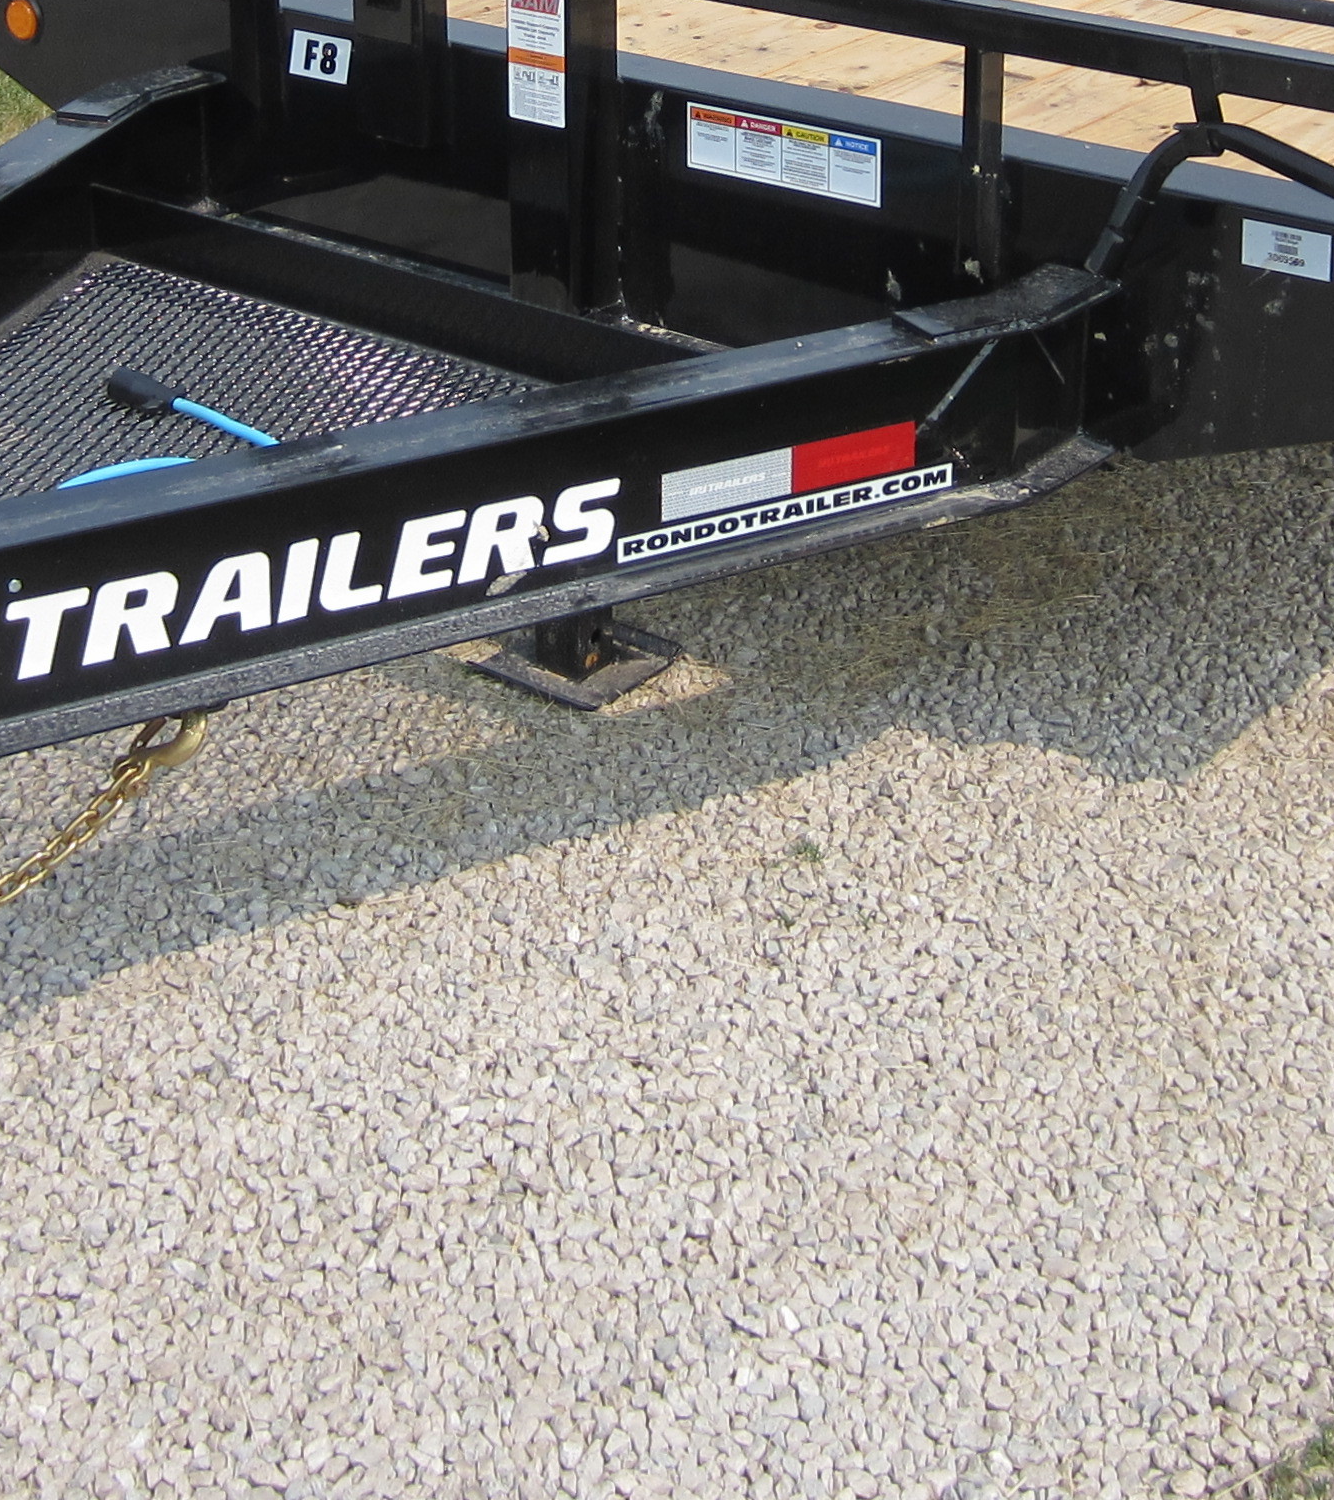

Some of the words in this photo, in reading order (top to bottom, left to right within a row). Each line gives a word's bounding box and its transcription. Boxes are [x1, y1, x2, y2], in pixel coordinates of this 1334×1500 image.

[304, 38, 338, 75] F8
[749, 121, 777, 133] DANGER
[795, 131, 825, 143] CAUTION
[845, 140, 870, 151] NOTICE
[622, 468, 948, 557] RONDOTRAILER.COM
[4, 479, 621, 681] TRAILERS
